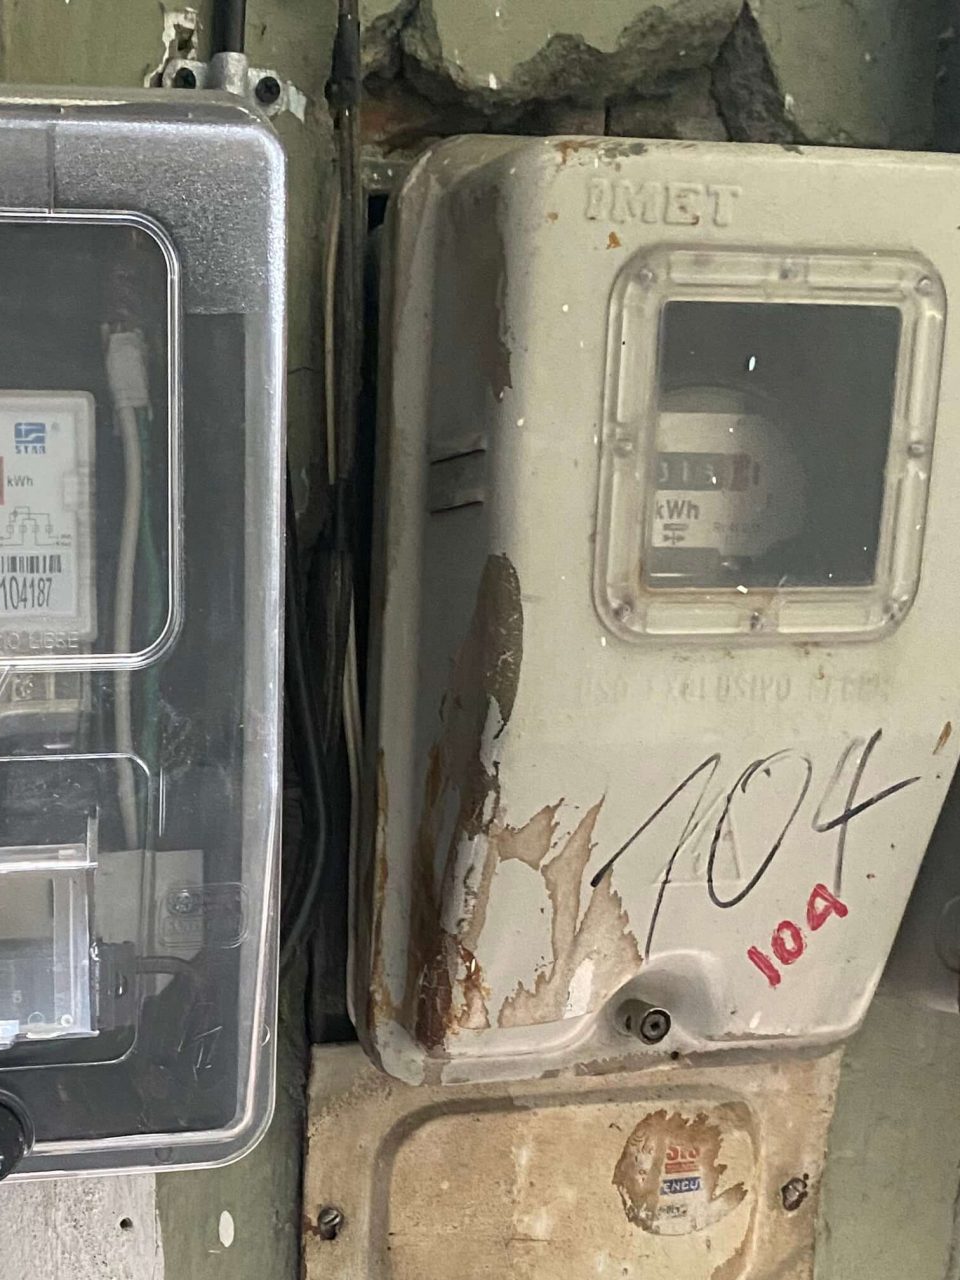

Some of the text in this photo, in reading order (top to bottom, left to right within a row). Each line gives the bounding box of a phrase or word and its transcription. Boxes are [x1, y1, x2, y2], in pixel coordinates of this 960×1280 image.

[15, 445, 46, 454] STAR
[7, 475, 33, 487] kWh
[656, 499, 699, 520] kWh
[29, 631, 79, 649] LIBRE
[590, 728, 921, 961] 104
